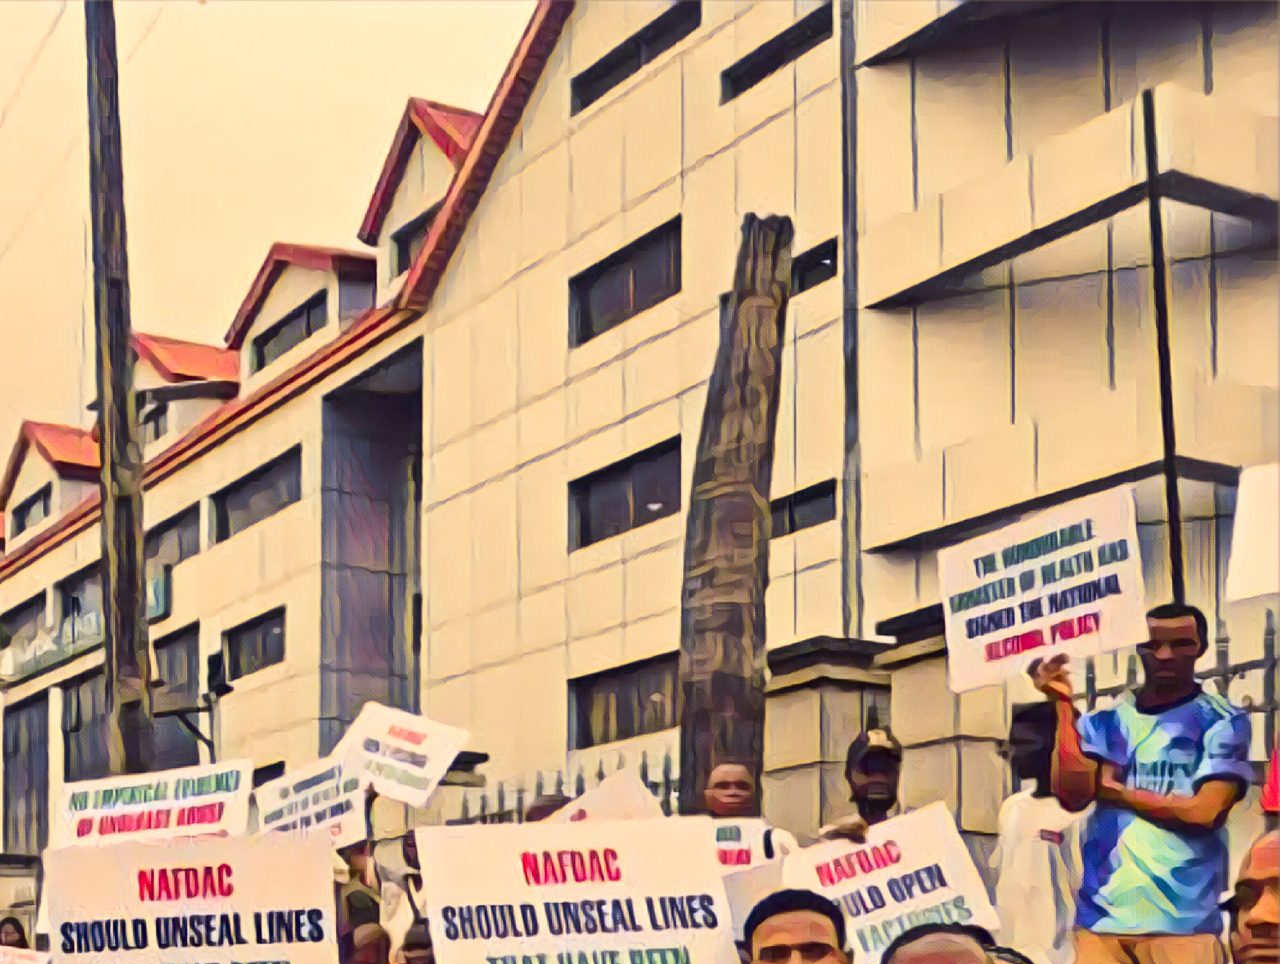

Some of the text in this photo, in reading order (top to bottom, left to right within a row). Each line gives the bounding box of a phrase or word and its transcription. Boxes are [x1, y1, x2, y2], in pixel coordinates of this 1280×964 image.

[137, 863, 234, 901] NAFDAC
[520, 848, 621, 886] NAFDAC
[815, 840, 902, 887] NAFDAC
[887, 863, 948, 903] OPEN
[60, 908, 324, 953] SHOULD UNSEAL LINES
[442, 894, 718, 940] SHOULD UNSEAL LINES
